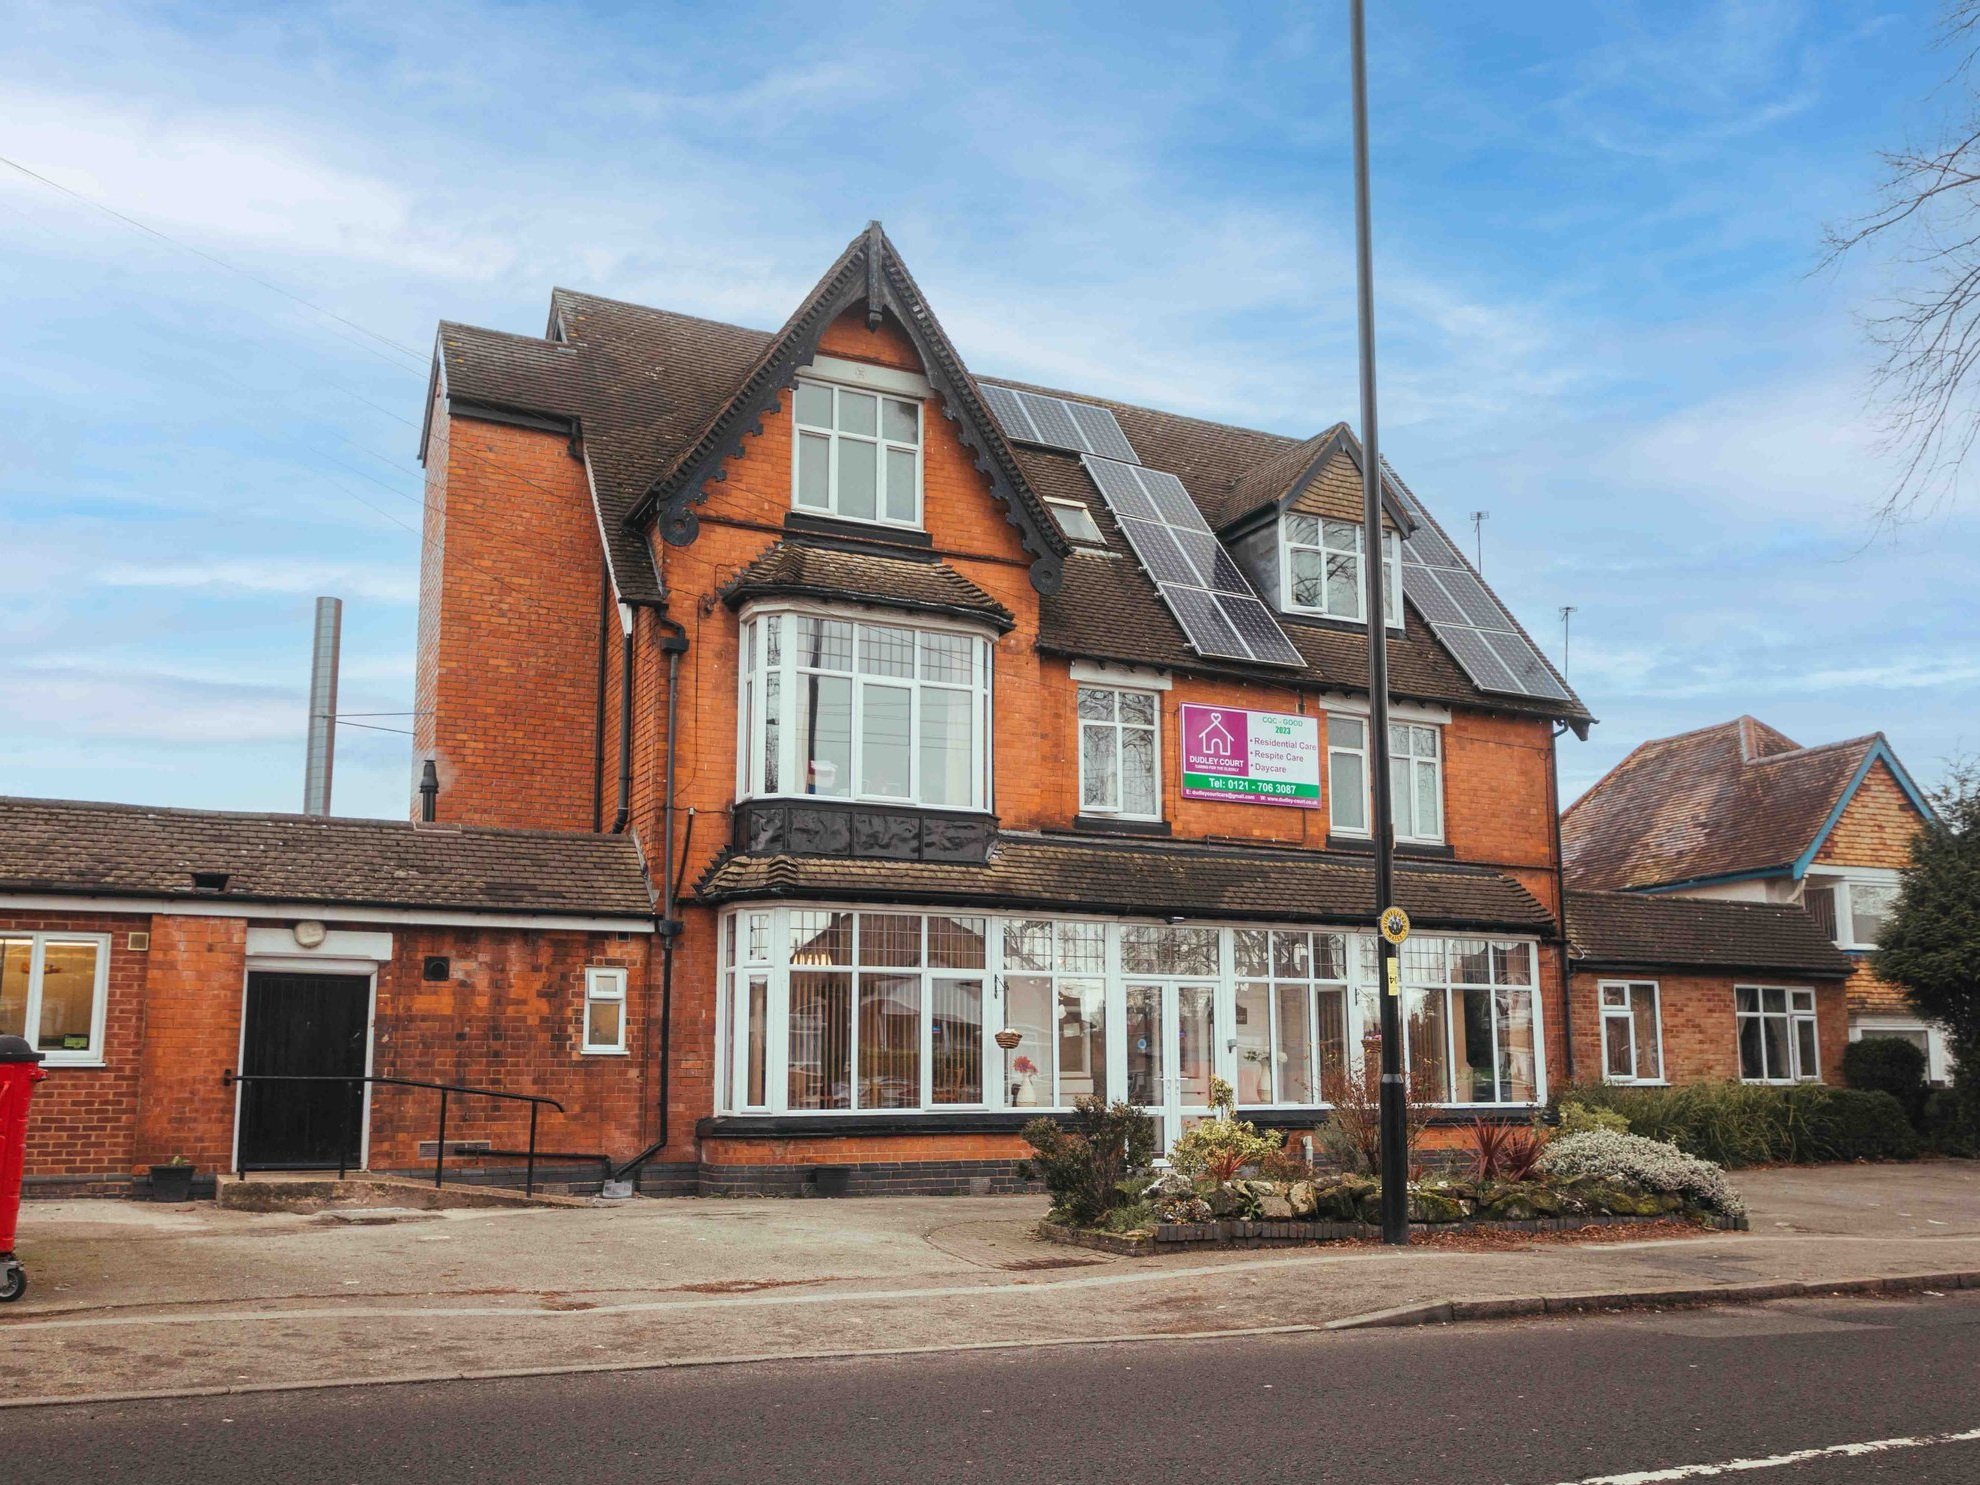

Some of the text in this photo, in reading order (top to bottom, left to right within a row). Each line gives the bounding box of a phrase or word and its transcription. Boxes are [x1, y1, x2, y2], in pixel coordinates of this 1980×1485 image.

[1282, 718, 1303, 727] GOOD
[1275, 726, 1291, 735] 2023
[1254, 738, 1317, 751] Residential Care
[1190, 755, 1244, 767] DUDLEY COURT
[1254, 749, 1304, 762] Respite Care
[1255, 763, 1287, 773] Daycare
[1208, 777, 1226, 788] Tel:
[1227, 779, 1249, 790] 0121
[1257, 782, 1274, 792] 706
[1275, 783, 1297, 794] 3087
